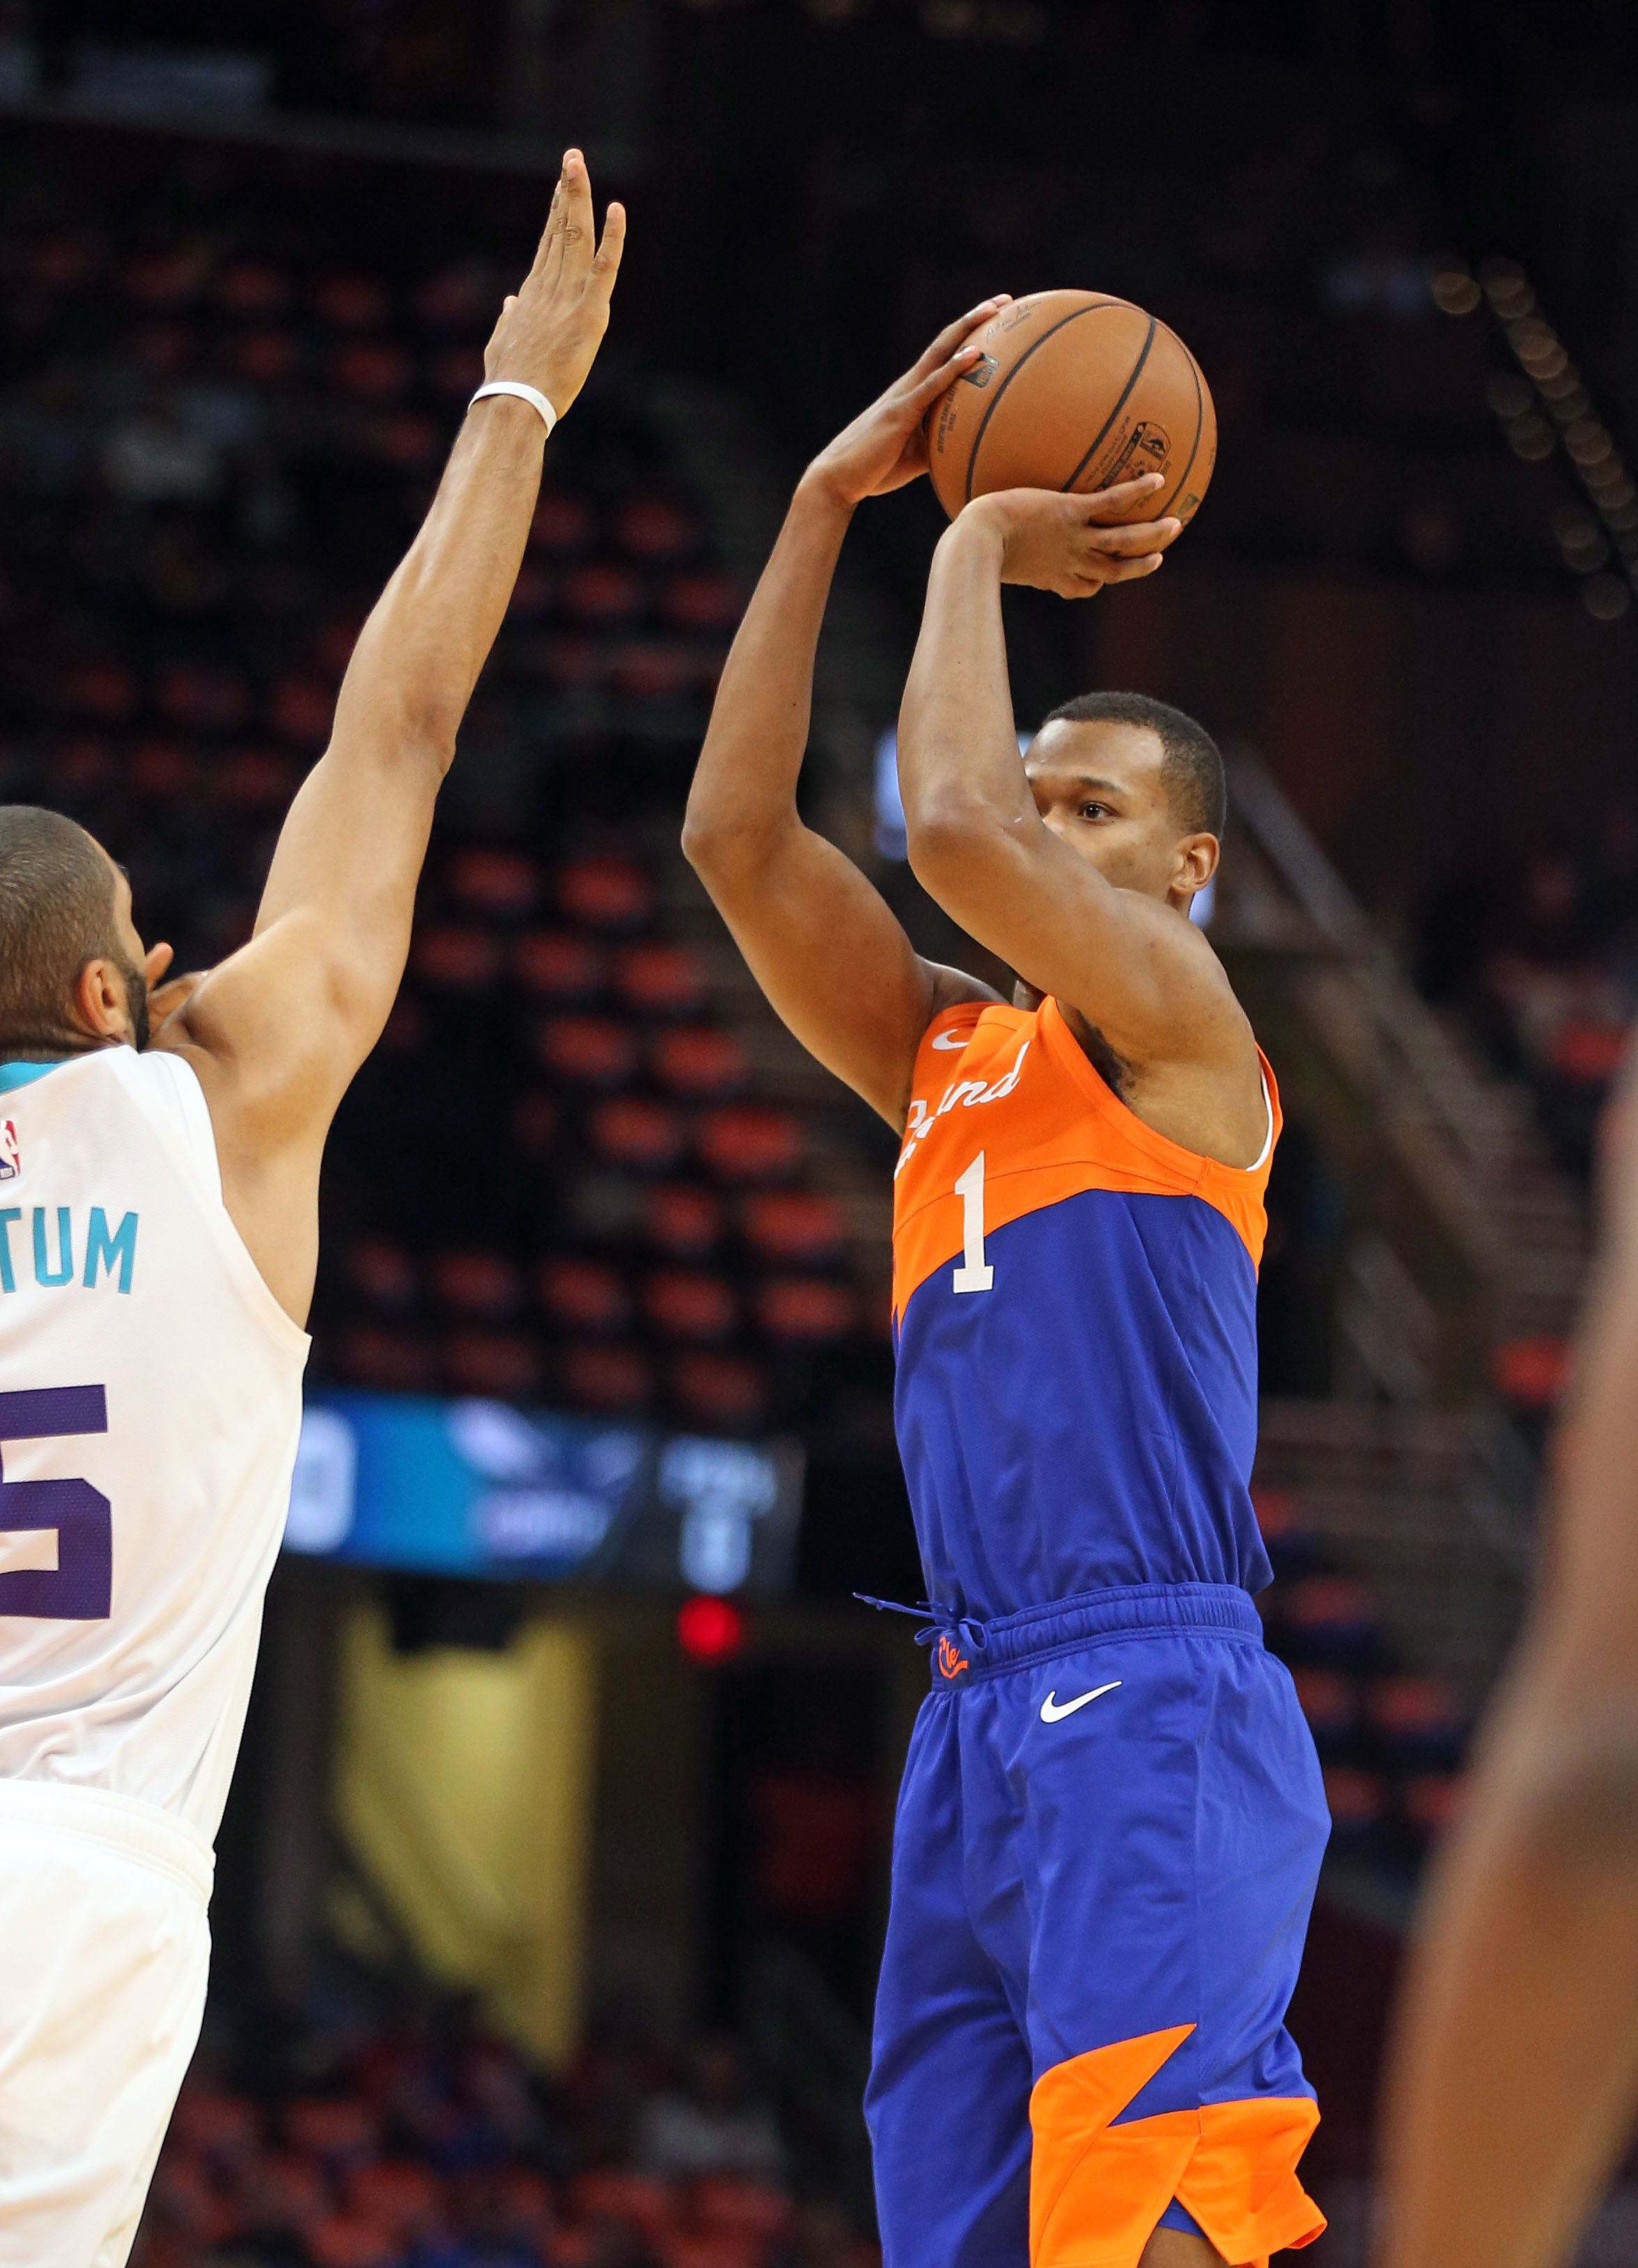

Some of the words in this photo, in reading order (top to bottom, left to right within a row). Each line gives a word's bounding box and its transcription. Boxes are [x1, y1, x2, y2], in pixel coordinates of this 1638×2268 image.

[0, 1207, 139, 1294] TUM
[953, 1150, 994, 1294] 1
[0, 1384, 112, 1620] 5
